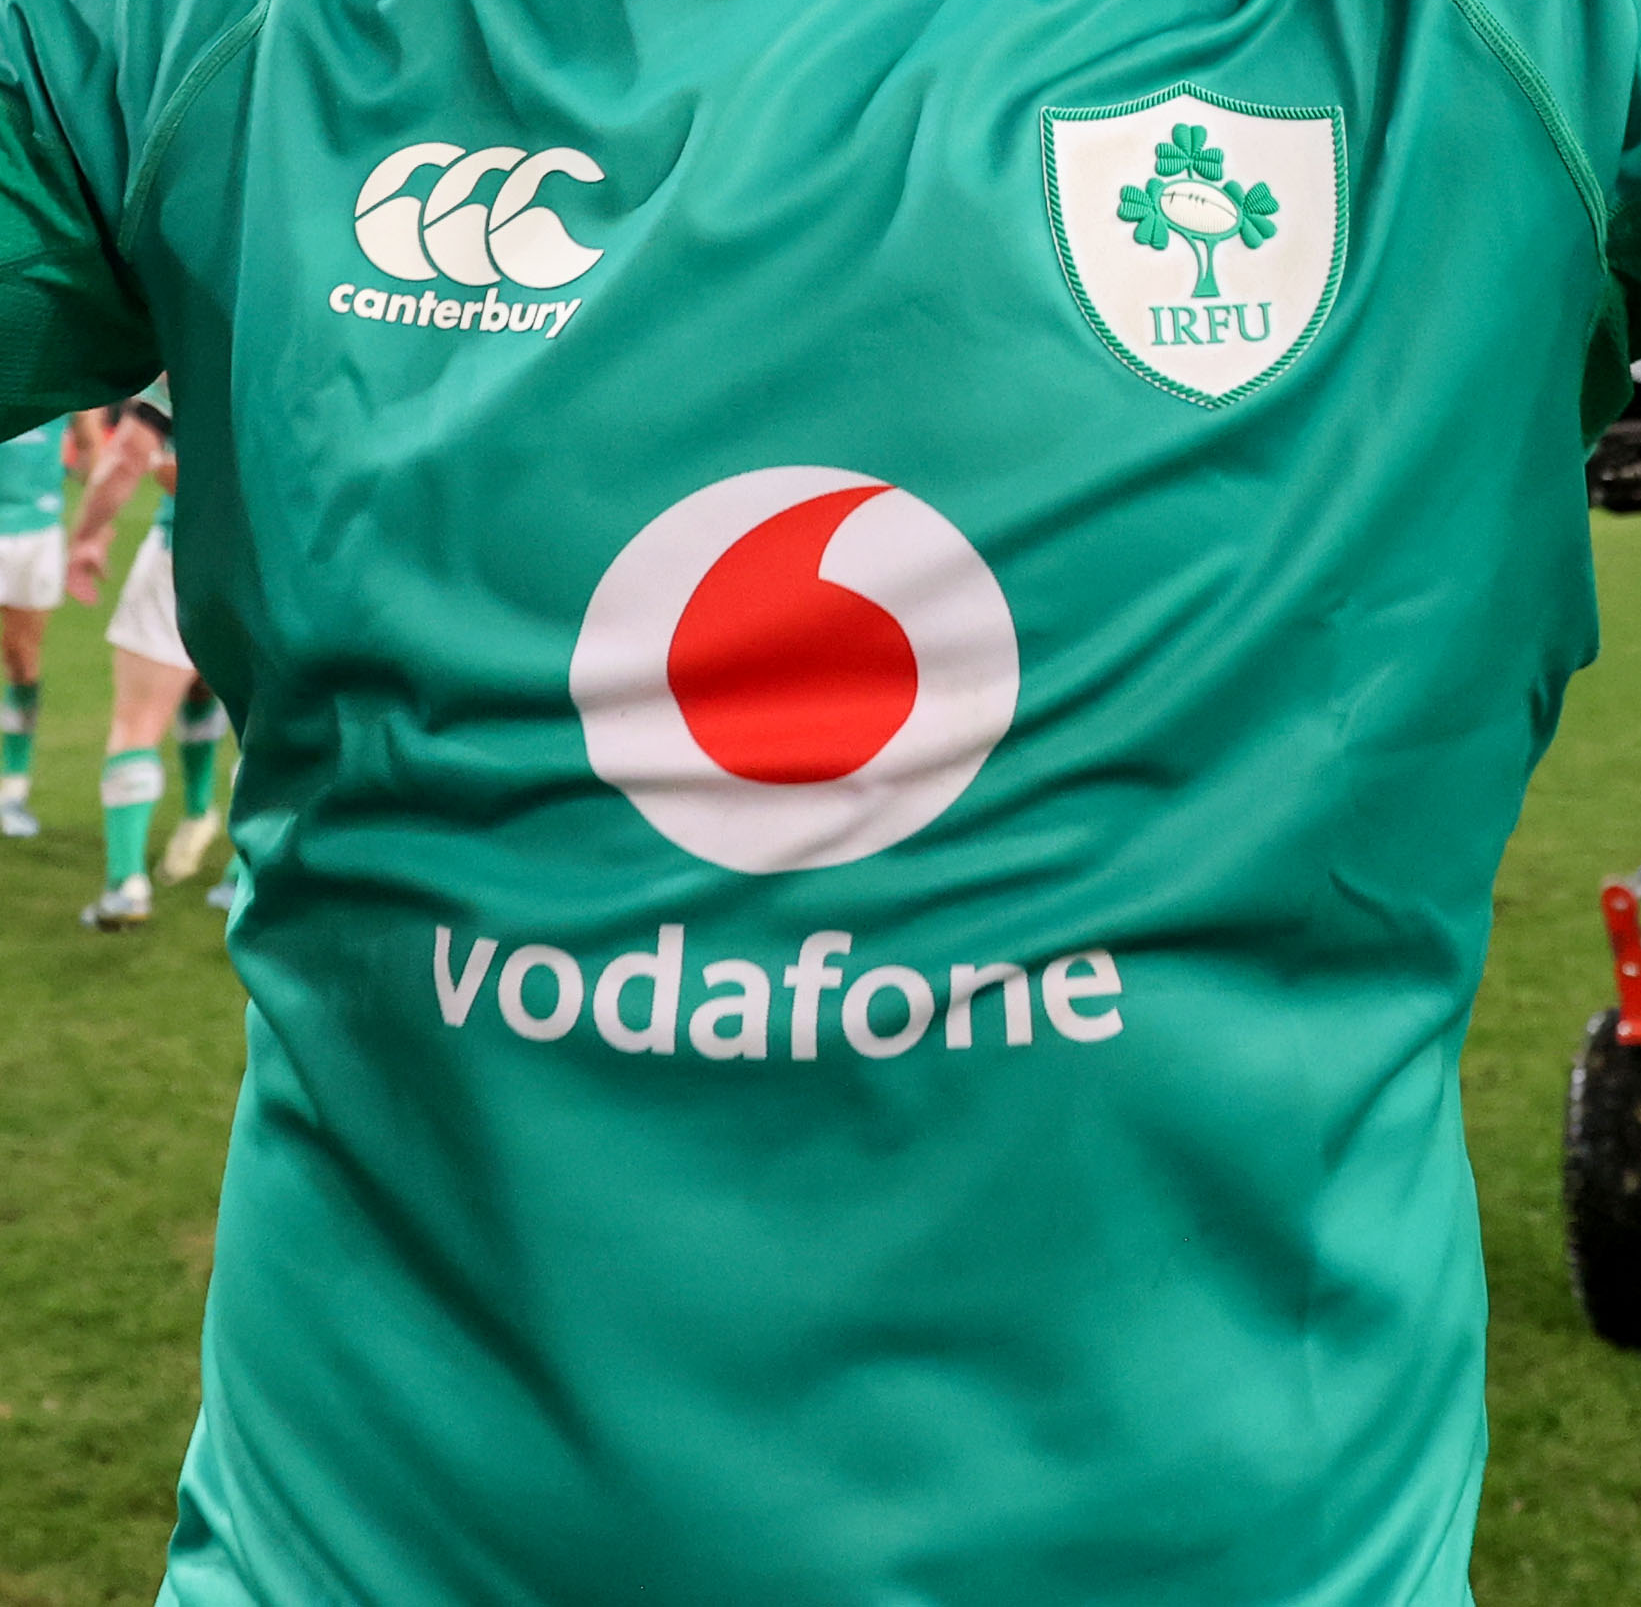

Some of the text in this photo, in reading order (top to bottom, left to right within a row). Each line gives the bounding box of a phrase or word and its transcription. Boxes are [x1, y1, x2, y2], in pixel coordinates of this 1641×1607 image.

[328, 282, 584, 340] canterbury
[1148, 302, 1272, 346] IRFU
[434, 922, 1124, 1061] vodafone
